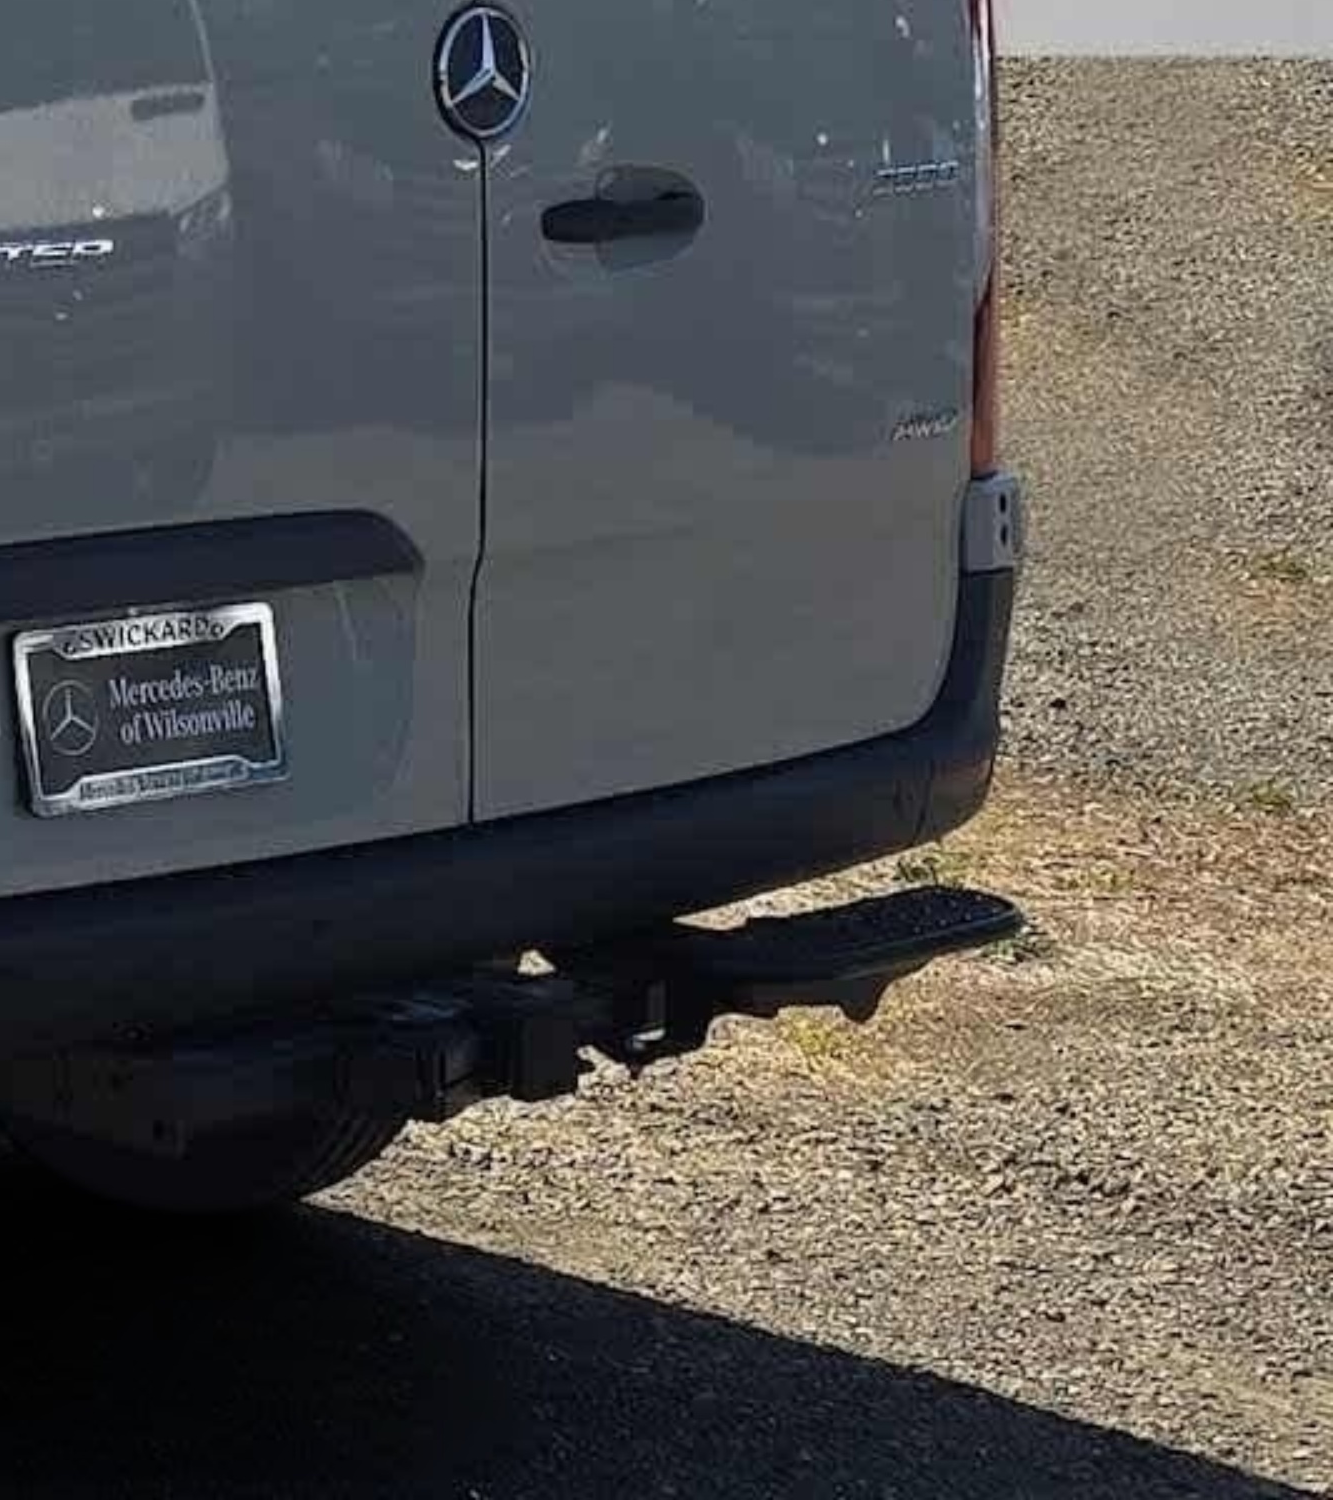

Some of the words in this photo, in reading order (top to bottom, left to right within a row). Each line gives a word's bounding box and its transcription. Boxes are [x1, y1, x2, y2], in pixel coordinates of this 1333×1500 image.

[79, 615, 209, 652] SWICKARD
[109, 663, 258, 709] Mercedes-Benz
[120, 711, 144, 746] of
[143, 699, 255, 741] Wilsonville
